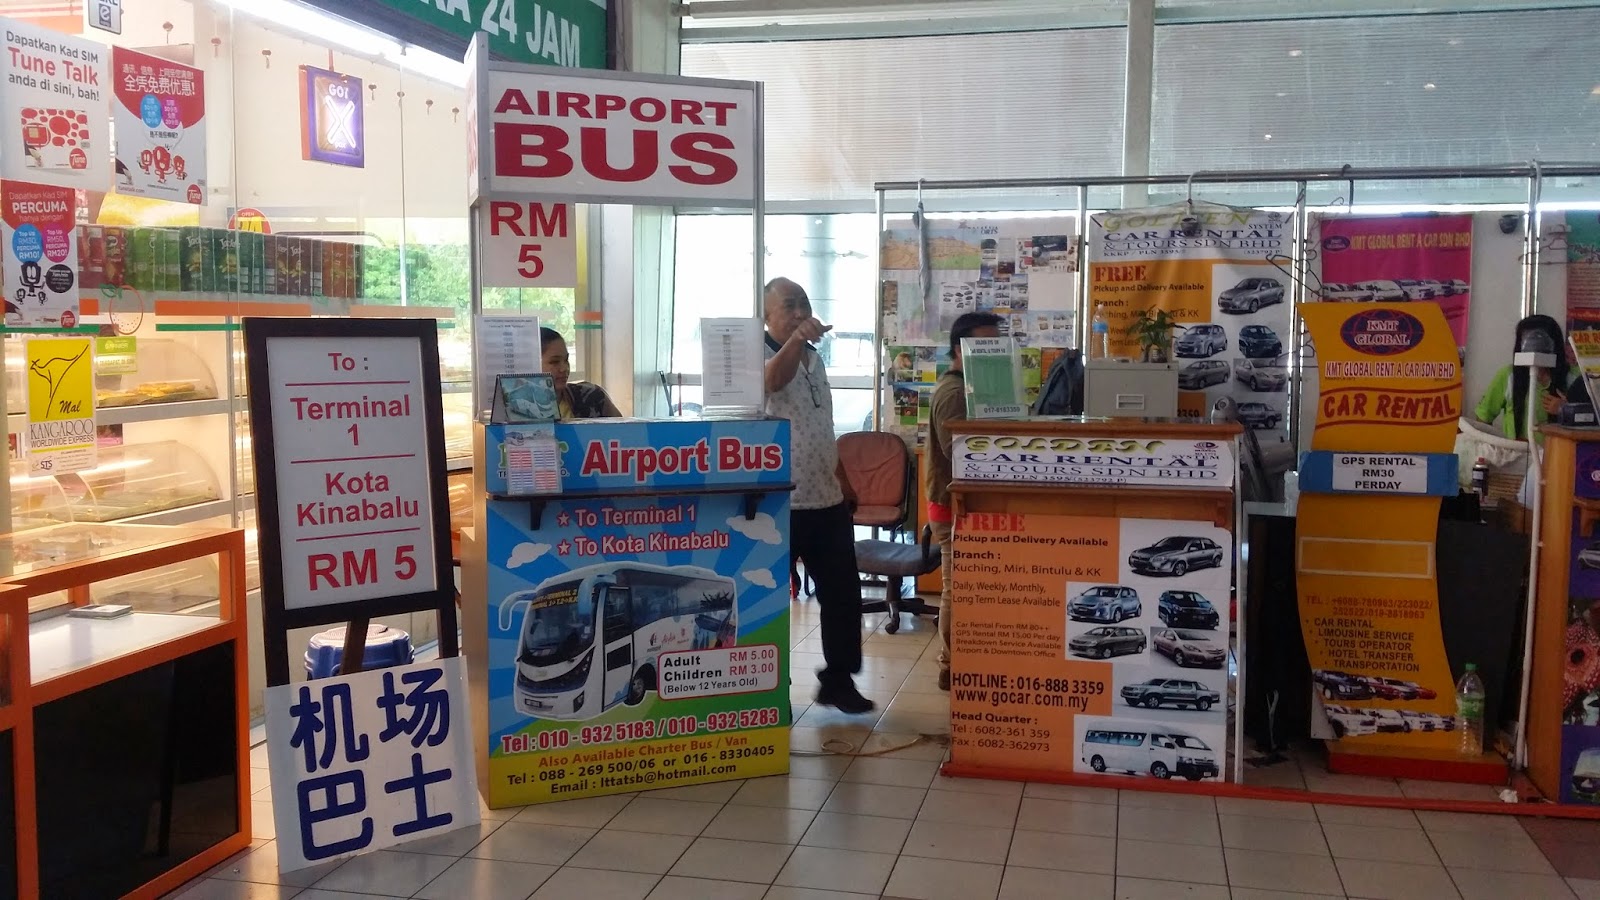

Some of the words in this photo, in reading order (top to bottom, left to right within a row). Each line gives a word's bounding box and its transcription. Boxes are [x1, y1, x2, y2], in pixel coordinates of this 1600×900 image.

[481, 0, 518, 44] 24
[526, 2, 580, 68] JAM
[6, 31, 57, 53] Dapatkan
[60, 44, 79, 57] Kad
[81, 50, 98, 63] SIM
[8, 47, 56, 76] Tune
[63, 60, 98, 86] Talk
[9, 73, 37, 88] anda
[40, 77, 50, 91] di
[53, 81, 75, 99] sini,
[78, 86, 100, 101] bah!
[494, 88, 738, 126] AIRPORT
[493, 121, 739, 186] BUS
[12, 201, 68, 214] PERCUMA
[490, 201, 568, 239] RM
[1104, 230, 1157, 241] CAR
[1368, 234, 1395, 248] GLOBAL
[1397, 234, 1414, 247] RENT
[1424, 233, 1438, 246] CAR
[1455, 232, 1470, 245] BHD
[47, 249, 68, 257] RM20!
[1122, 239, 1188, 250] TOURS
[1194, 239, 1232, 248] SDN
[1239, 240, 1281, 248] BHD
[19, 251, 40, 259] RM10!
[517, 244, 544, 279] 5
[1094, 265, 1147, 282] FREE
[1094, 285, 1119, 293] Pickup
[1137, 284, 1167, 293] Delivery
[1169, 283, 1204, 291] Available
[1367, 320, 1399, 331] KMT
[1354, 334, 1410, 345] GLOBAL
[327, 352, 356, 371] To
[1326, 362, 1342, 376] KMT
[1344, 362, 1373, 377] GLOBAL
[1376, 363, 1394, 377] RENT
[1405, 364, 1420, 377] CAR
[1421, 363, 1437, 377] SDN
[1439, 363, 1455, 377] BHD
[60, 400, 81, 414] Mal
[290, 394, 410, 421] Terminal
[1324, 393, 1367, 418] CAR
[1376, 394, 1455, 419] RENTAL
[30, 419, 94, 440] KANGAROO
[347, 423, 359, 446] 1
[31, 437, 67, 448] WORLDWIDE
[68, 434, 94, 445] EXPRESS
[964, 436, 1166, 454] GOLDEN
[41, 460, 53, 470] STS
[582, 438, 711, 483] Airport
[718, 438, 783, 472] Bus
[964, 452, 1042, 463] CAR
[1056, 455, 1218, 467] RENTAL
[1342, 457, 1365, 465] GPS
[1370, 458, 1416, 466] RENTAL
[991, 464, 1082, 475] TOURS
[1092, 467, 1146, 477] SDN
[1158, 469, 1217, 478] BHD
[1362, 469, 1395, 478] RM30
[325, 471, 389, 496] Kota
[1355, 481, 1402, 490] PERDAY
[296, 496, 420, 527] Kinabalu
[574, 507, 598, 528] To
[601, 504, 684, 526] Terminal
[955, 513, 1025, 532] FREE
[575, 537, 598, 556] To
[602, 534, 646, 555] Kota
[649, 530, 730, 552] Kinabalu
[953, 534, 988, 544] Pickup
[990, 535, 1010, 543] and
[1013, 535, 1056, 546] Delivery
[1059, 537, 1108, 547] Available
[953, 550, 994, 560] Branch
[307, 548, 378, 592] RM
[394, 544, 417, 581] 5
[953, 564, 1000, 575] Kuching,
[1004, 565, 1027, 575] Miri,
[1031, 566, 1073, 576] Bintulu
[1086, 568, 1101, 577] KK
[953, 581, 975, 592] Daily,
[976, 582, 1007, 593] Weekly,
[1010, 583, 1046, 593] Monthly,
[953, 595, 972, 606] Long
[975, 596, 995, 604] Term
[997, 596, 1020, 605] Lease
[1022, 597, 1060, 607] Available
[1314, 618, 1334, 626] CAR
[1338, 619, 1374, 628] RENTAL
[1319, 629, 1370, 638] LIMOUSINE
[1374, 631, 1414, 640] SERVICE
[991, 648, 1031, 656] Downtown
[1325, 639, 1355, 648] TOURS
[1360, 641, 1411, 651] OPERATOR
[663, 655, 701, 668] Adult
[729, 651, 748, 662] RM
[751, 650, 774, 660] 5.00
[1329, 650, 1359, 658] HOTEL
[1363, 651, 1414, 661] TRANSFER
[663, 667, 722, 682] Children
[729, 665, 748, 676] RM
[751, 663, 774, 674] 3.00
[1334, 660, 1419, 672] TRANSPORTATION
[663, 683, 696, 695] (Below
[698, 682, 709, 691] 12
[710, 680, 736, 690] Years
[738, 678, 758, 688] Old)
[952, 673, 1008, 688] HOTLINE
[1017, 677, 1069, 692] 016-888
[1072, 680, 1104, 694] 3359
[955, 690, 1088, 711] www.gocar.com.my
[289, 667, 451, 773] 机场
[952, 711, 982, 721] Head
[985, 713, 1032, 725] Quarter
[502, 735, 528, 752] Tel
[539, 730, 570, 749] 010
[582, 726, 613, 745] 932
[616, 720, 655, 742] 5183
[668, 716, 696, 735] 010
[708, 712, 737, 731] 932
[739, 707, 779, 727] 5283
[952, 724, 967, 733] Tel
[975, 726, 1025, 737] 6082-361
[1030, 729, 1050, 738] 359
[539, 756, 568, 768] Also
[572, 747, 636, 765] Available
[639, 741, 688, 757] Charter
[690, 737, 713, 750] Bus
[725, 736, 748, 747] Van
[952, 738, 969, 747] Fax
[978, 739, 1050, 752] 6082-362973
[508, 773, 527, 786] Tel
[539, 769, 566, 782] 088
[578, 765, 603, 777] 269
[608, 758, 656, 774] 500/06
[684, 752, 708, 764] 016
[720, 745, 775, 760] 8330405
[551, 779, 588, 794] Email
[601, 762, 737, 788] lttatsb@hotmail.com
[296, 752, 453, 861] 巴士
